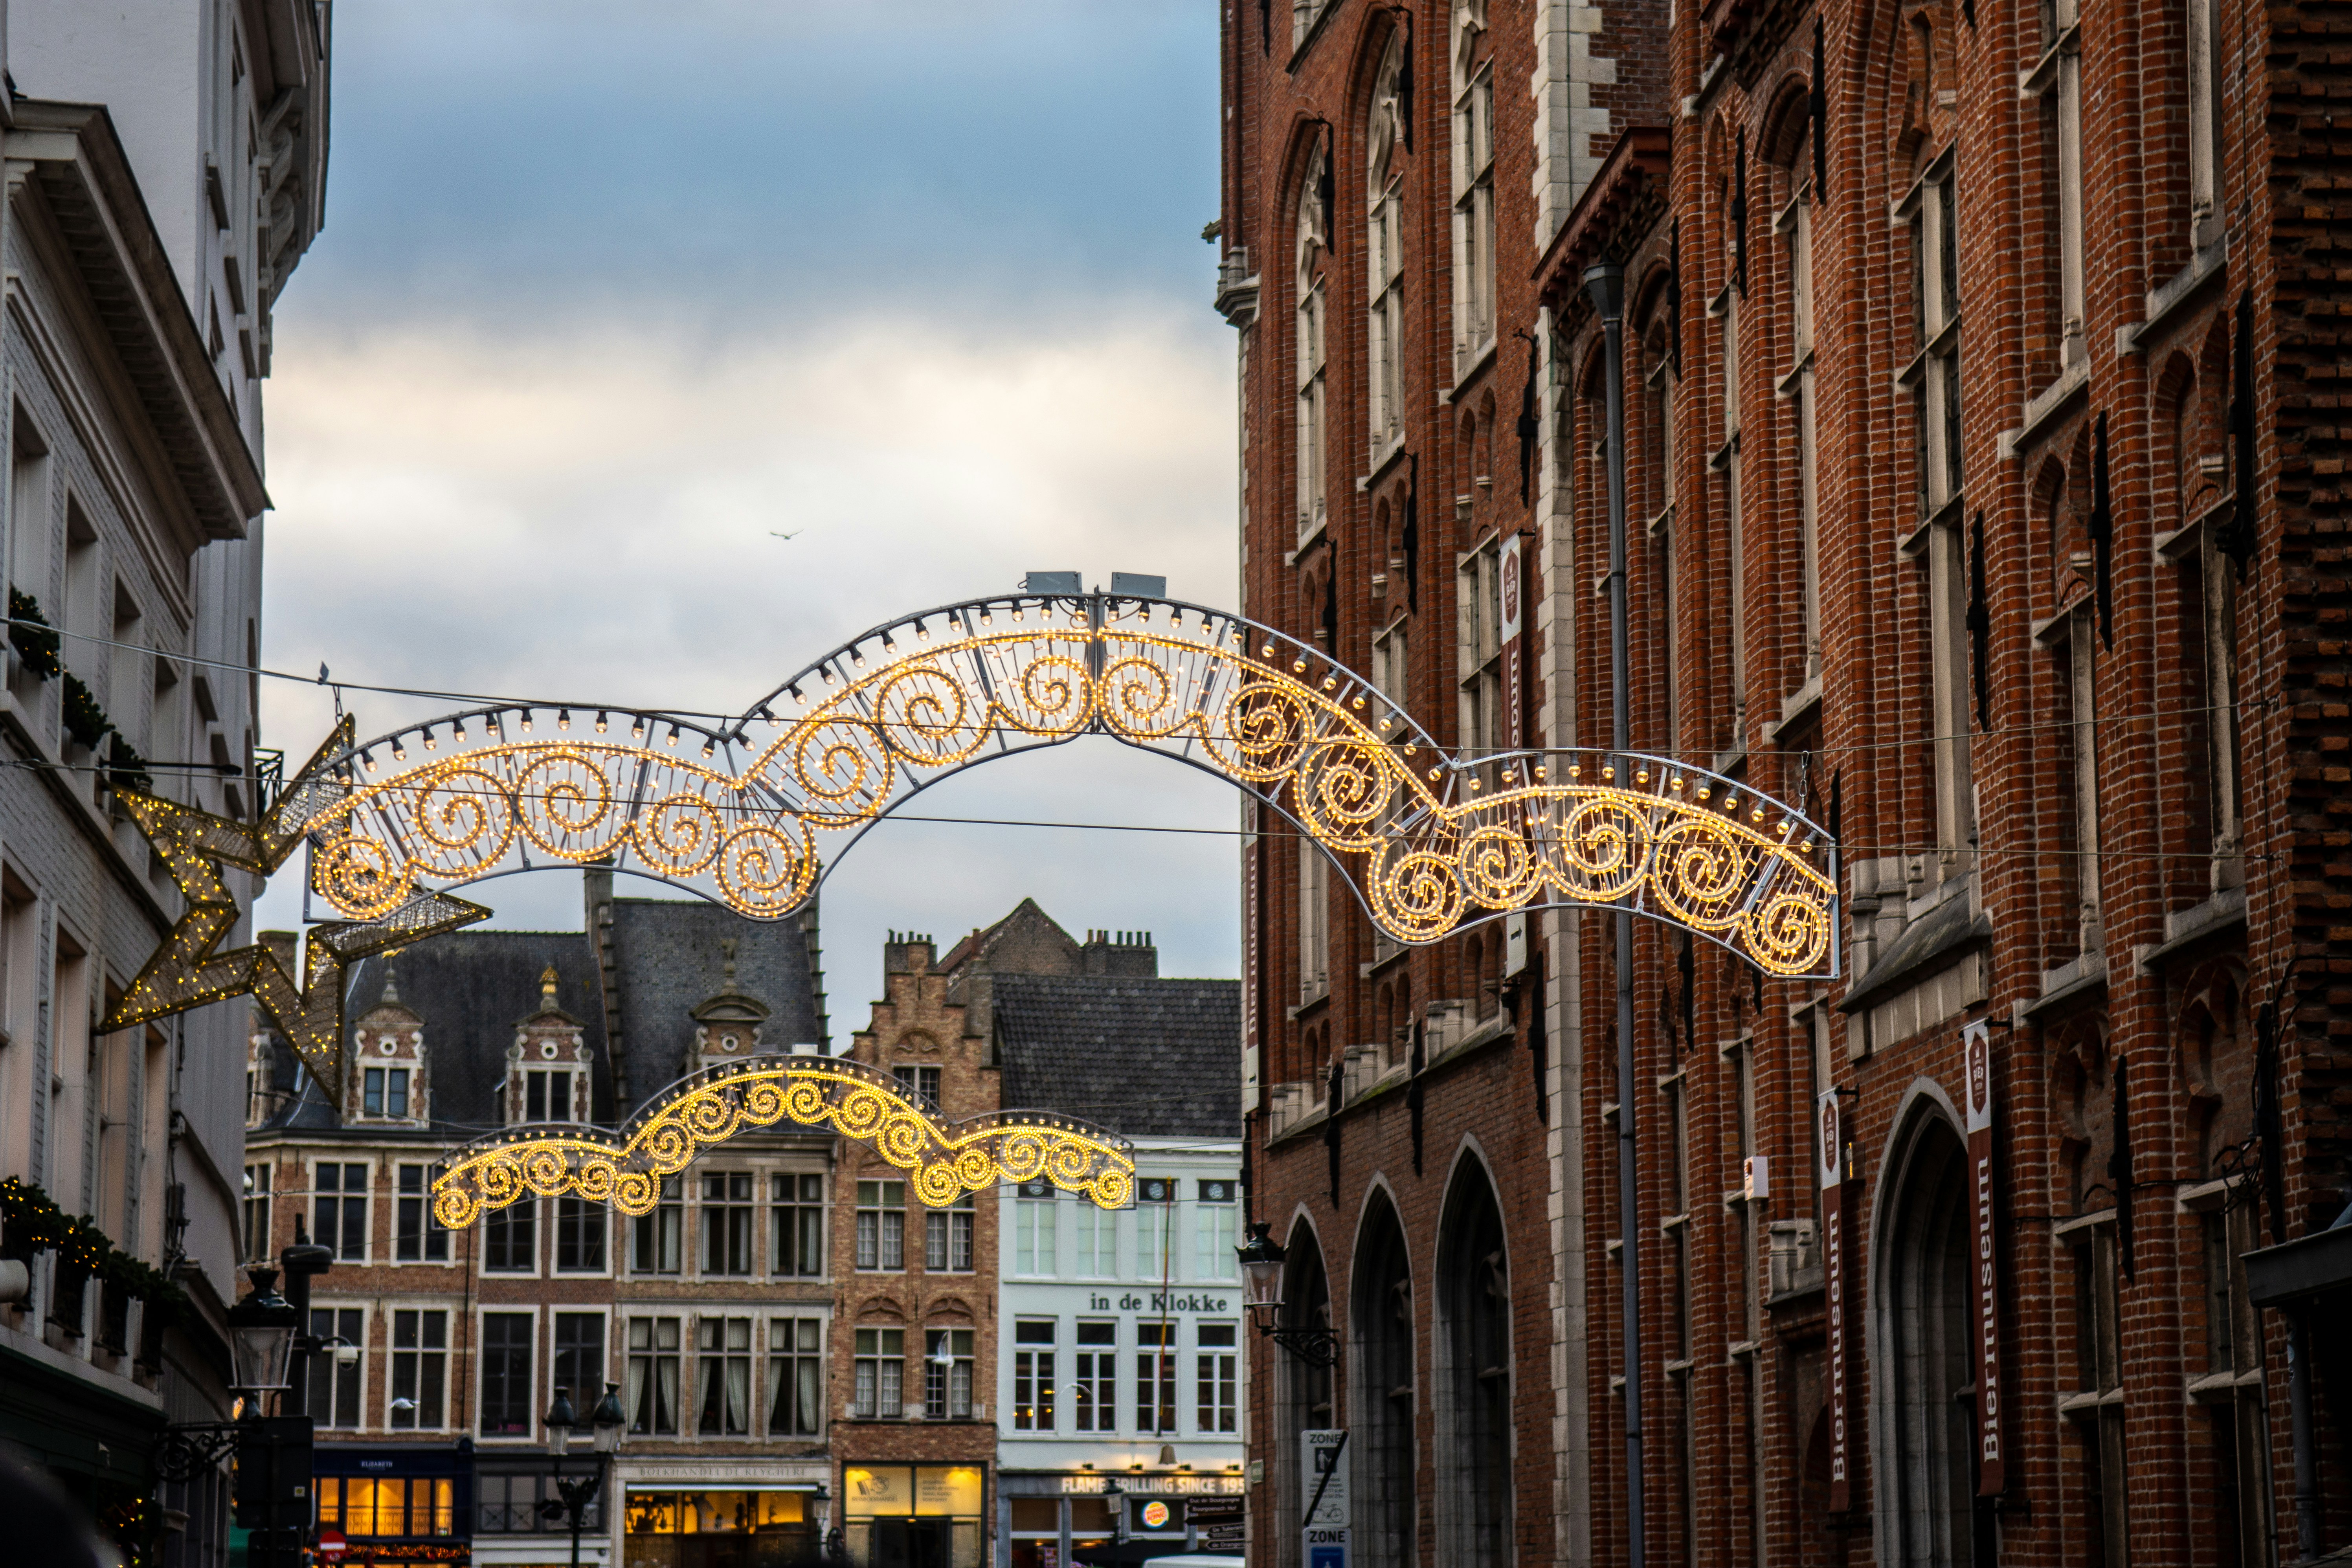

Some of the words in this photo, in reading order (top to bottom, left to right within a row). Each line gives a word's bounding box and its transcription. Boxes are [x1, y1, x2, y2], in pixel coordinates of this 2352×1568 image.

[1091, 1292, 1110, 1310] in
[1120, 1292, 1142, 1311] de
[1151, 1293, 1227, 1312] Klokke
[1977, 1156, 1999, 1463] Biermuseum
[1829, 1210, 1845, 1482] Biermuseum
[1310, 1434, 1342, 1444] ZONE
[1062, 1477, 1105, 1493] FLAME
[1177, 1477, 1215, 1493] SINCE
[1309, 1530, 1346, 1542] ZONE
